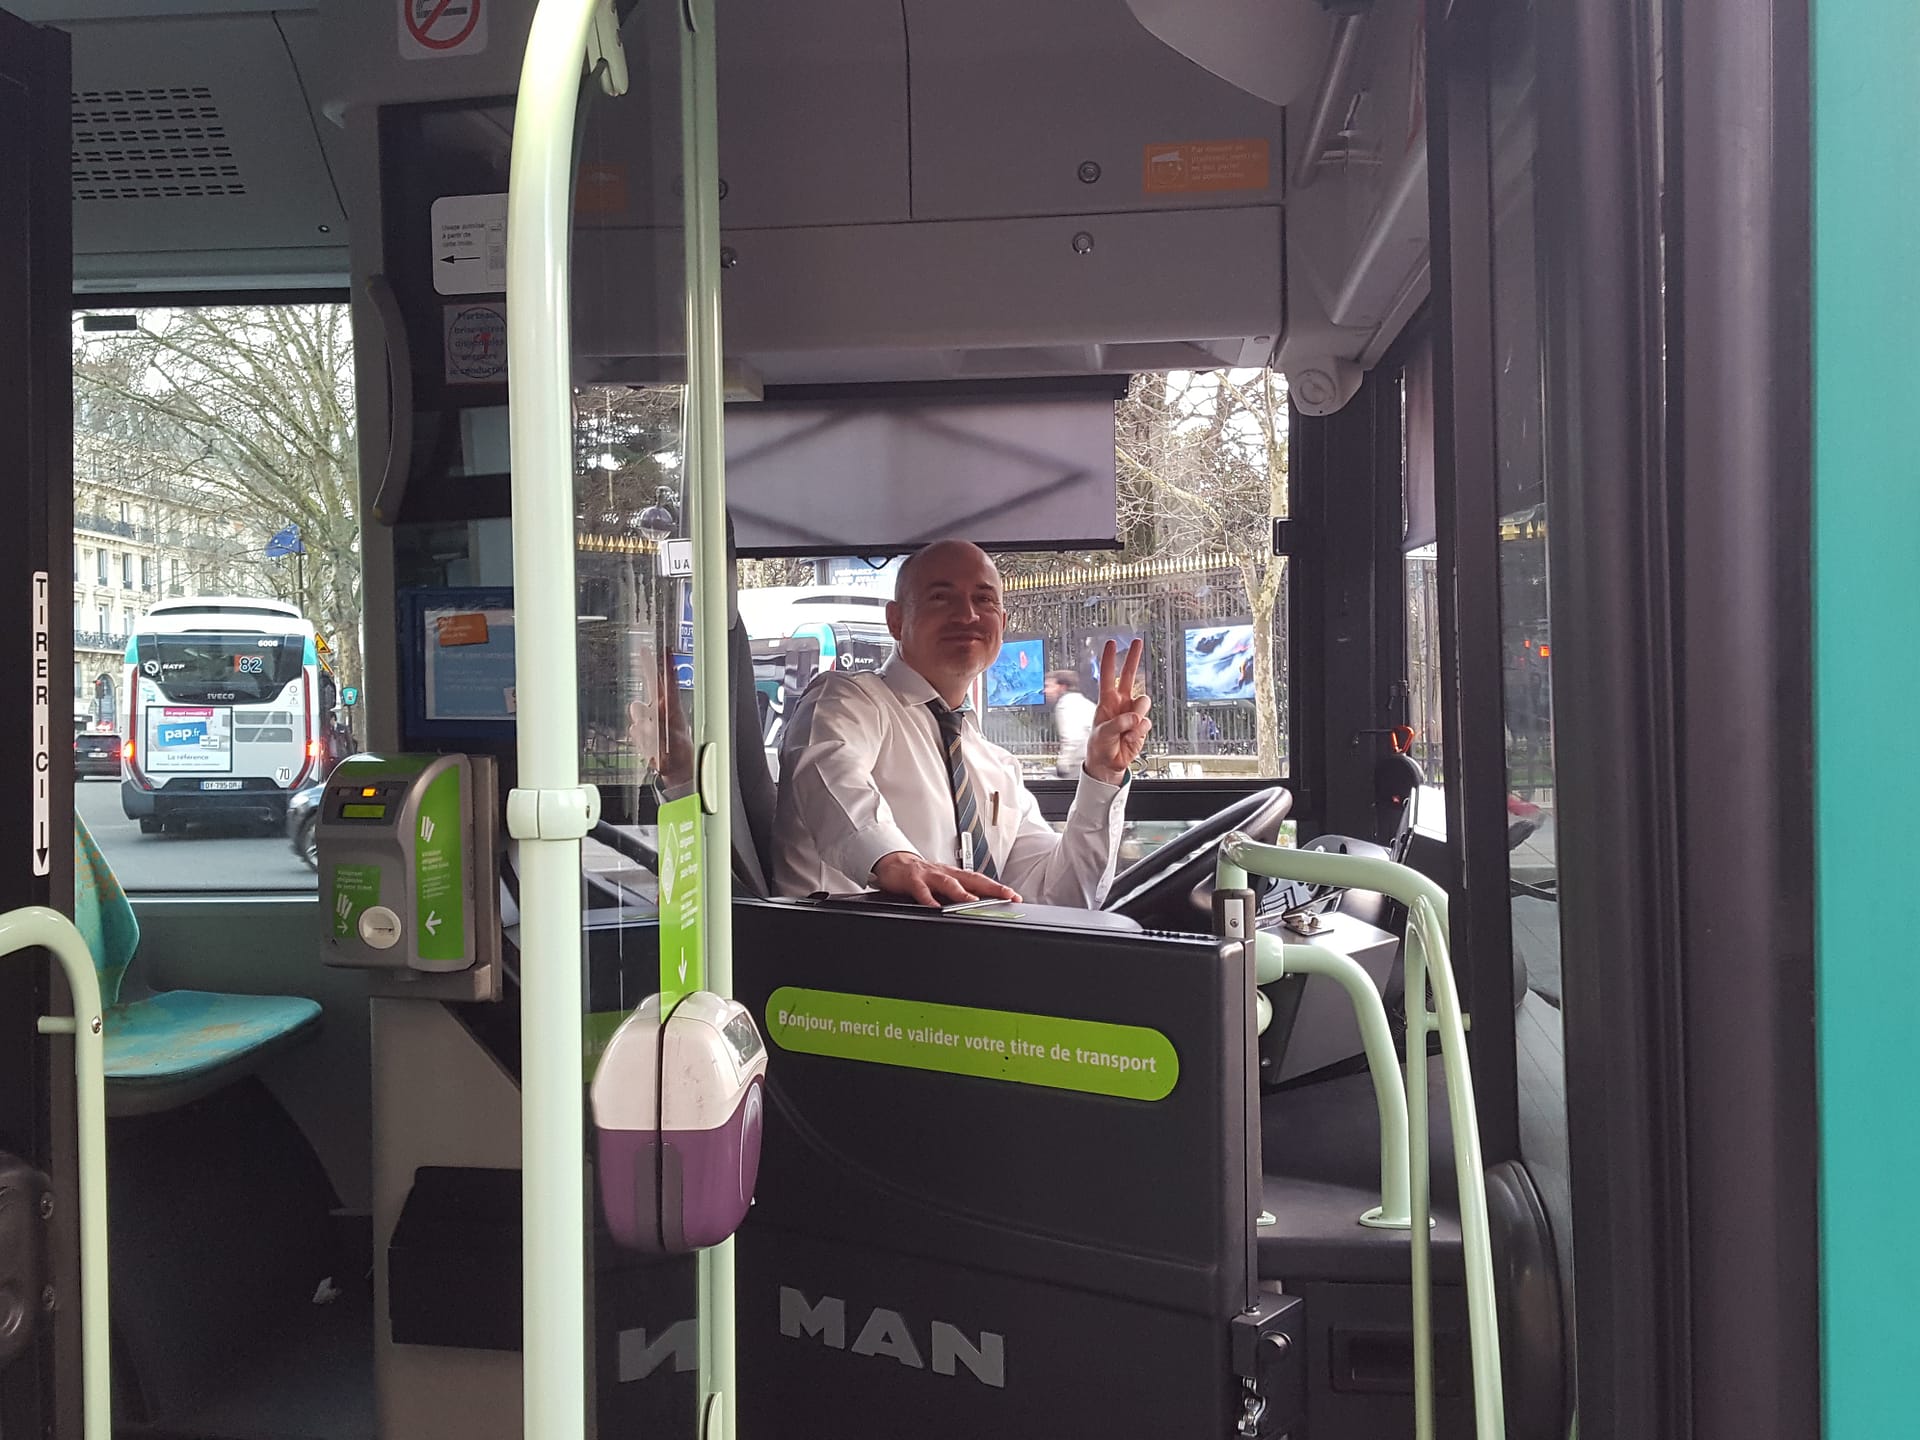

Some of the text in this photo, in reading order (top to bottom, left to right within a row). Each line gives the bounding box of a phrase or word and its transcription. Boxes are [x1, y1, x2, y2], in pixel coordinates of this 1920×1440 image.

[239, 656, 263, 674] 82
[36, 578, 48, 798] TIRER ICI
[207, 692, 235, 701] IVECO
[164, 728, 200, 742] pap.fr
[278, 768, 290, 780] 70
[778, 1009, 1157, 1073] Bonjour, merci de valider votre titre de transport
[779, 1285, 1006, 1388] MAN
